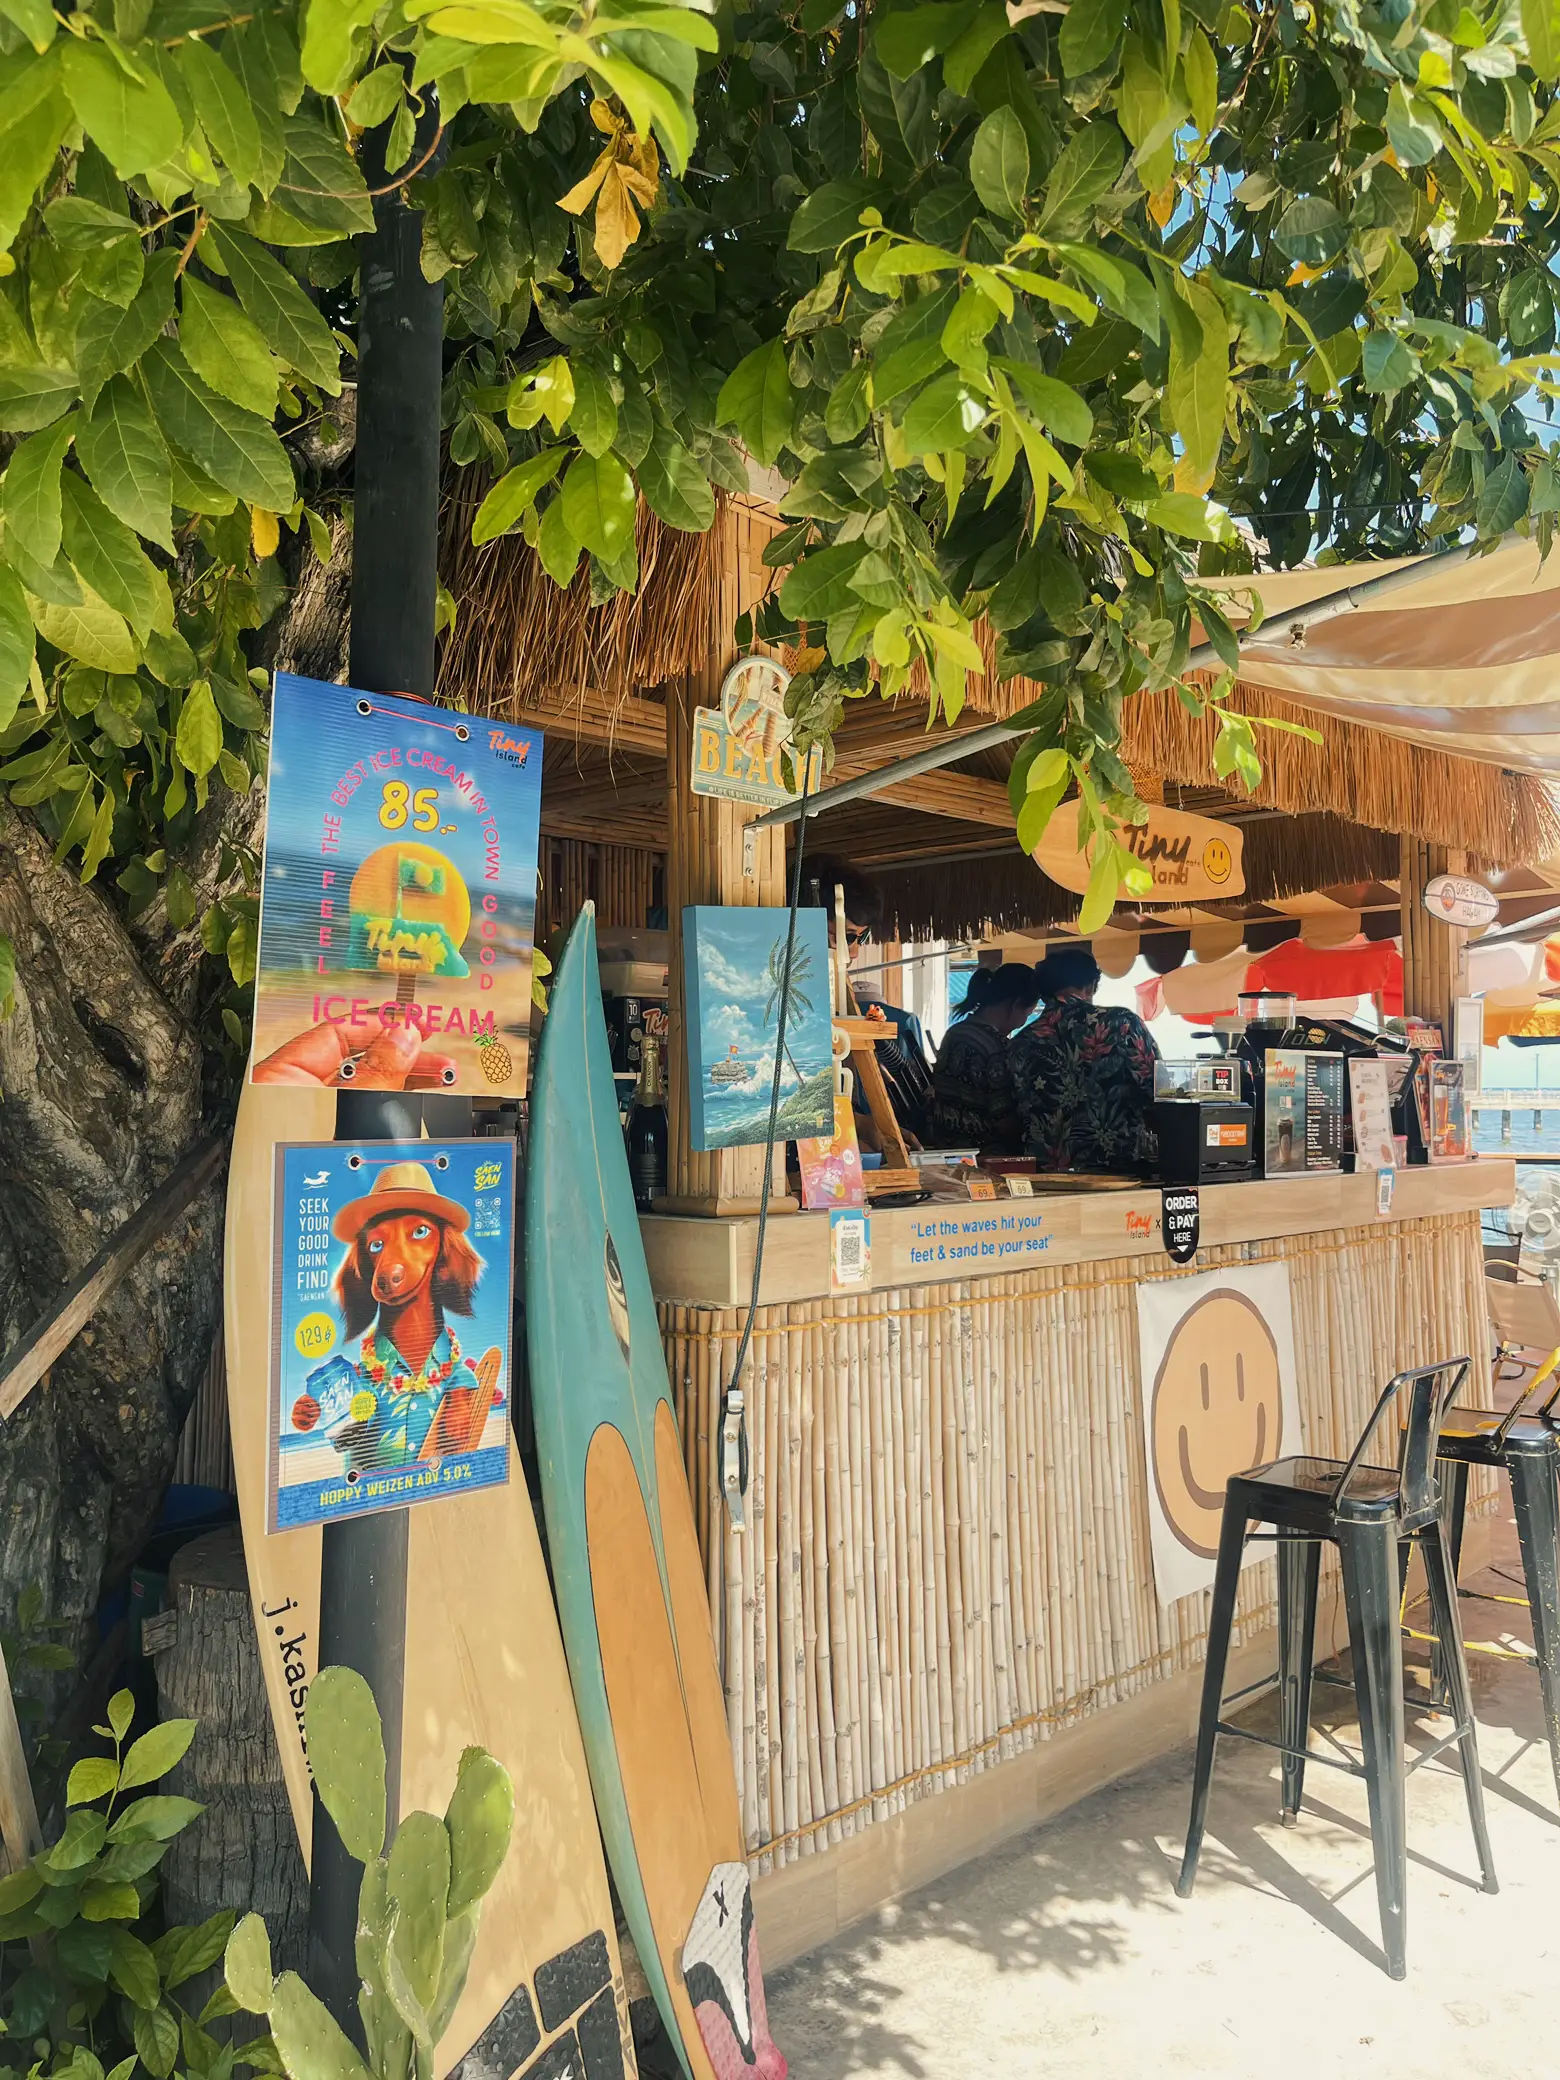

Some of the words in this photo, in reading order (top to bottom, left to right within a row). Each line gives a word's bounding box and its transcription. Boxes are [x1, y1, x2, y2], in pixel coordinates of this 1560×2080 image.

[488, 731, 531, 763] Tiny
[512, 763, 526, 771] cafe
[714, 788, 726, 796] LIFE
[728, 790, 735, 798] IS
[736, 791, 759, 801] BETTER
[321, 813, 341, 855] THE
[331, 764, 367, 808] BEST
[369, 748, 402, 772] ICE
[406, 748, 472, 795] CREAM
[469, 791, 488, 815] IN
[481, 816, 501, 882] TOWN
[378, 779, 458, 836] 85.-
[1123, 823, 1191, 874] Tiny
[1152, 865, 1188, 886] land
[317, 870, 336, 975] FEEL
[480, 894, 497, 991] GOOD
[312, 995, 367, 1027] ICE
[378, 1000, 494, 1037] CREAM
[1215, 1070, 1229, 1079] TIP
[474, 1173, 502, 1192] SAN
[299, 1197, 329, 1215] SEEK
[1165, 1195, 1198, 1211] ORDER
[299, 1216, 329, 1232] YOUR
[939, 1219, 958, 1236] the
[961, 1219, 997, 1234] waves
[1001, 1215, 1016, 1231] hit
[1017, 1214, 1043, 1236] your
[1125, 1210, 1153, 1232] Tiny
[1176, 1215, 1197, 1229] PAY
[298, 1234, 329, 1251] GOOD
[1129, 1230, 1151, 1239] Island
[1173, 1230, 1191, 1243] HERE
[298, 1253, 328, 1268] DRINK
[910, 1245, 935, 1264] feet
[937, 1244, 947, 1260] &
[949, 1241, 978, 1258] sand
[981, 1239, 996, 1256] be
[998, 1239, 1024, 1258] your
[297, 1270, 328, 1290] FIND
[300, 1325, 322, 1348] 129
[320, 1482, 362, 1506] HOPPY
[367, 1474, 414, 1497] WEIZEN
[416, 1470, 440, 1487] ABV
[443, 1463, 472, 1482] 5.0%
[262, 1597, 317, 1794] j.kas
